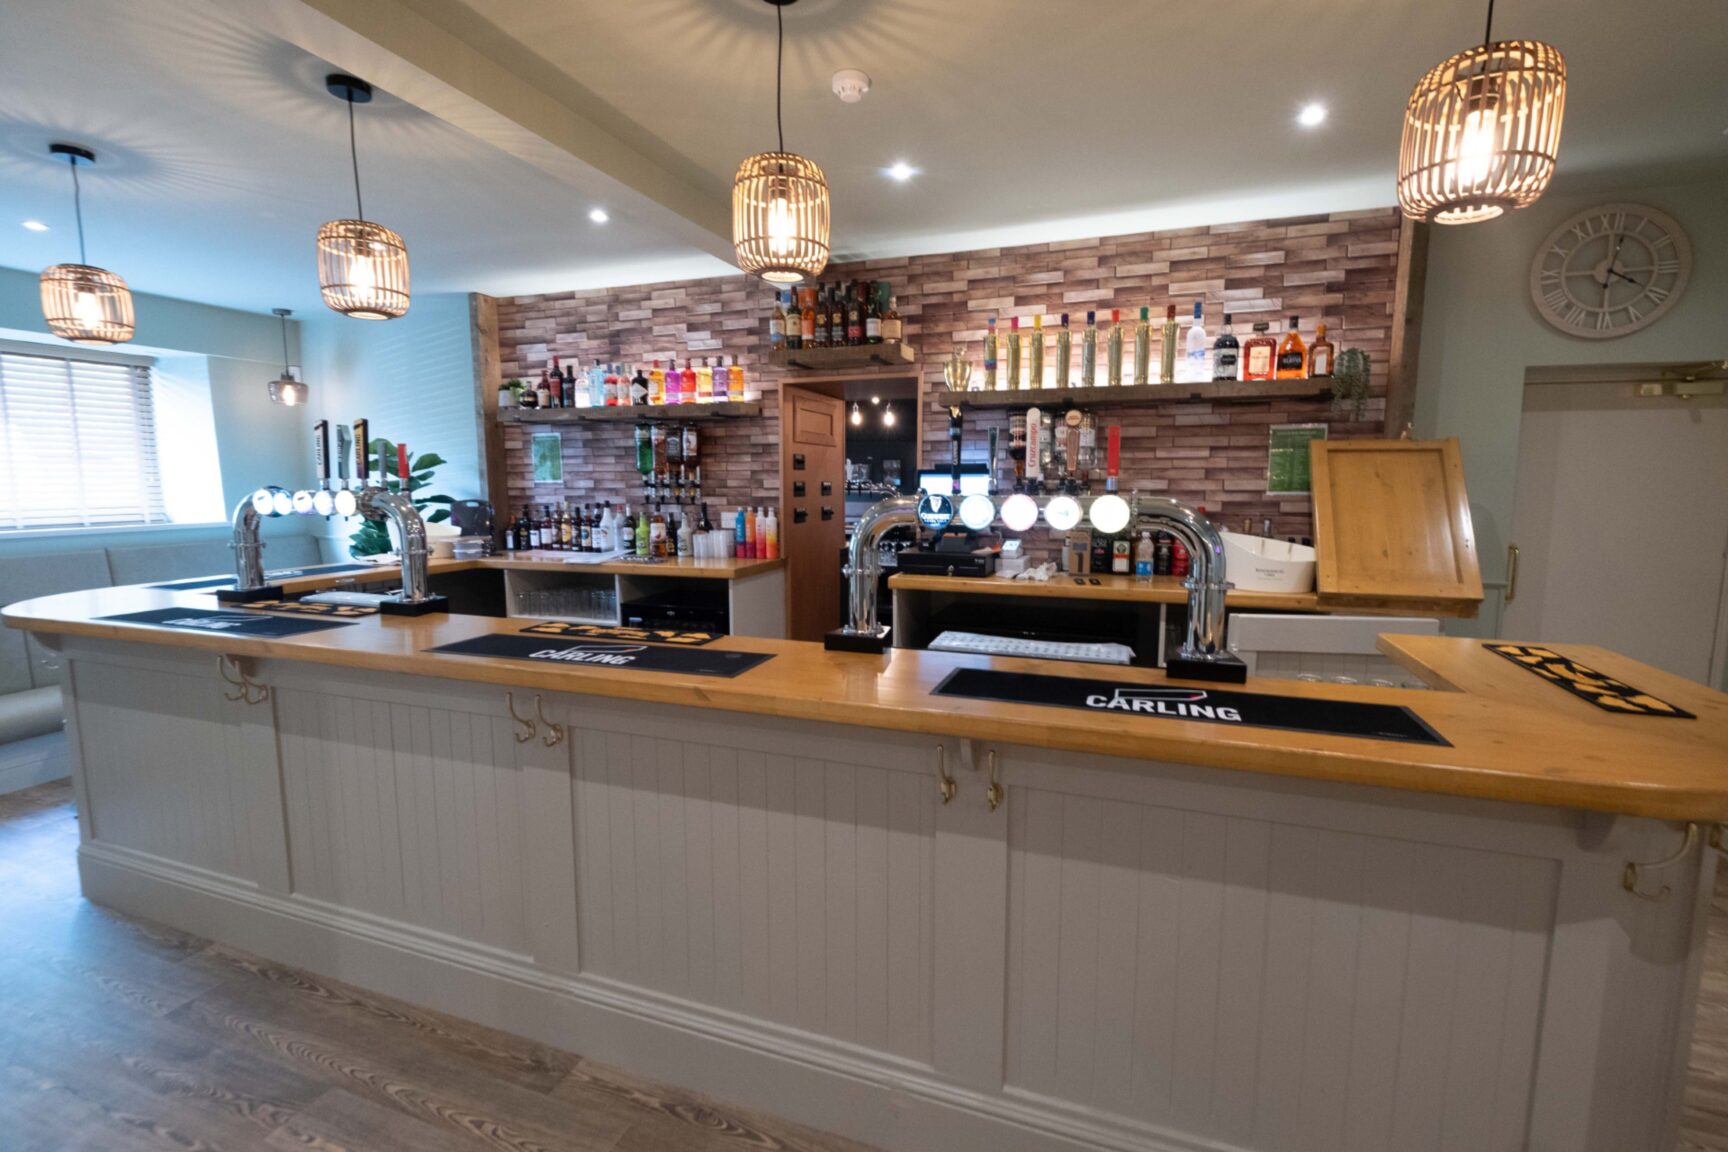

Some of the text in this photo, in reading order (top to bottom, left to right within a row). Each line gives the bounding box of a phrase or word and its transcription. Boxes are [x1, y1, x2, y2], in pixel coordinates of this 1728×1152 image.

[1571, 219, 1594, 241] XI
[1600, 212, 1626, 232] XII
[1654, 234, 1672, 248] II
[1551, 244, 1569, 258] X
[1658, 260, 1680, 274] III
[1541, 270, 1560, 285] IX
[1628, 306, 1643, 322] V
[1029, 423, 1038, 467] Cruzcampo
[528, 649, 636, 665] CARLING
[1086, 695, 1242, 721] CARLING
